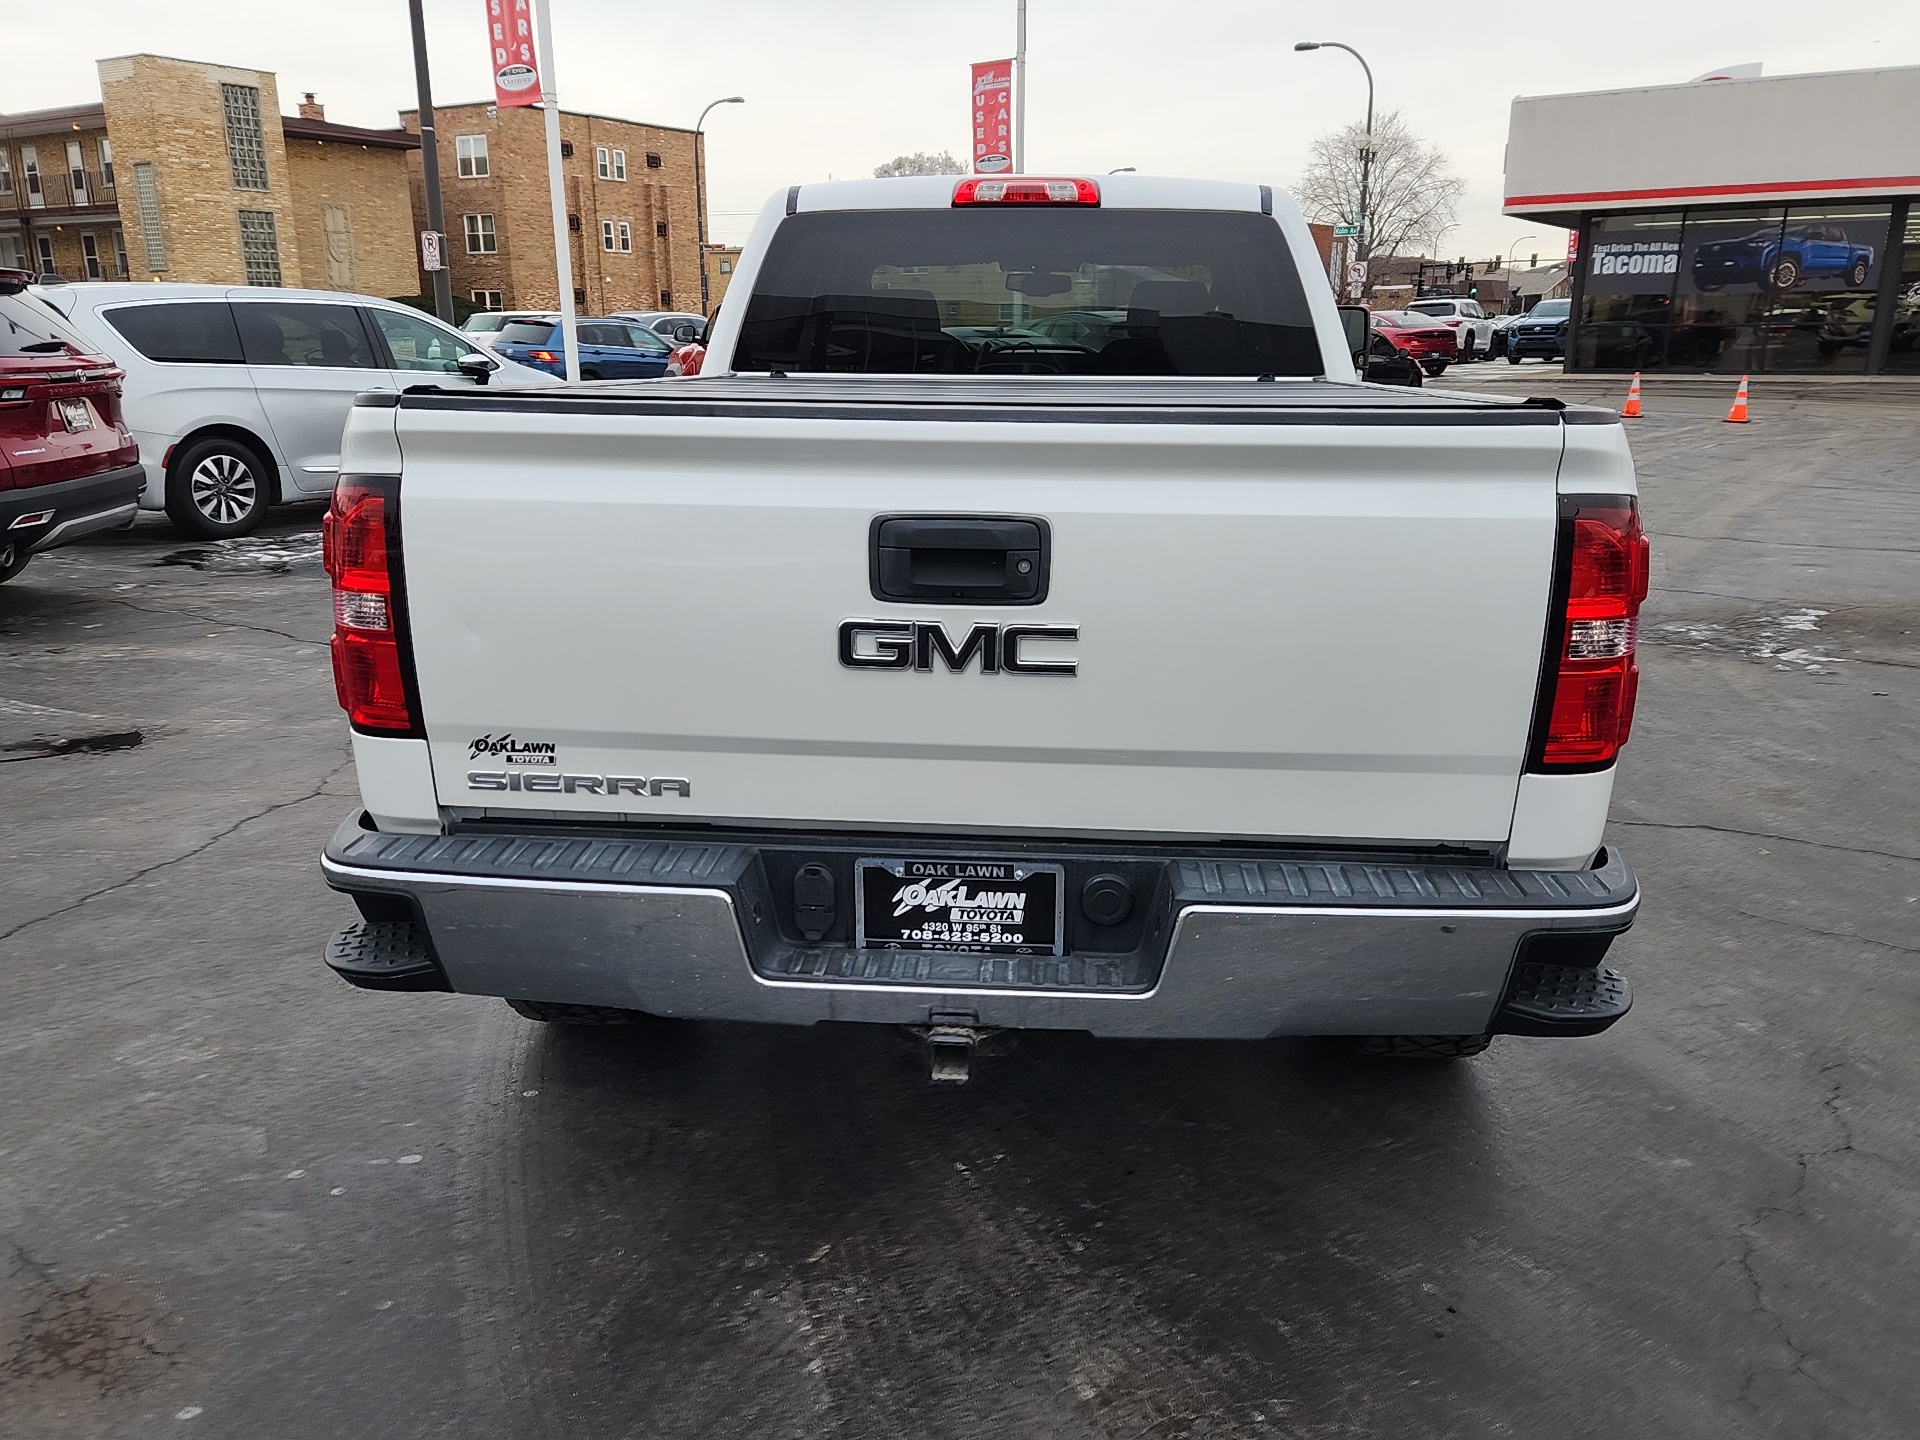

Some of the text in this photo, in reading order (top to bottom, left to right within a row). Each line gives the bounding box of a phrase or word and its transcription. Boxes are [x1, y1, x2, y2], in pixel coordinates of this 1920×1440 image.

[976, 95, 986, 154] USED
[998, 92, 1007, 152] CARS
[1593, 242, 1680, 253] Test Drive The All New
[1592, 252, 1678, 274] Tacoma
[838, 618, 1080, 676] GMC
[511, 755, 550, 764] TOYOTA
[467, 770, 691, 798] SIERRA
[912, 863, 1005, 878] OAK LAWN
[957, 909, 1015, 921] TOYOTA
[922, 922, 1002, 933] 4320 W 95th St
[901, 929, 1023, 943] 708-423-5200
